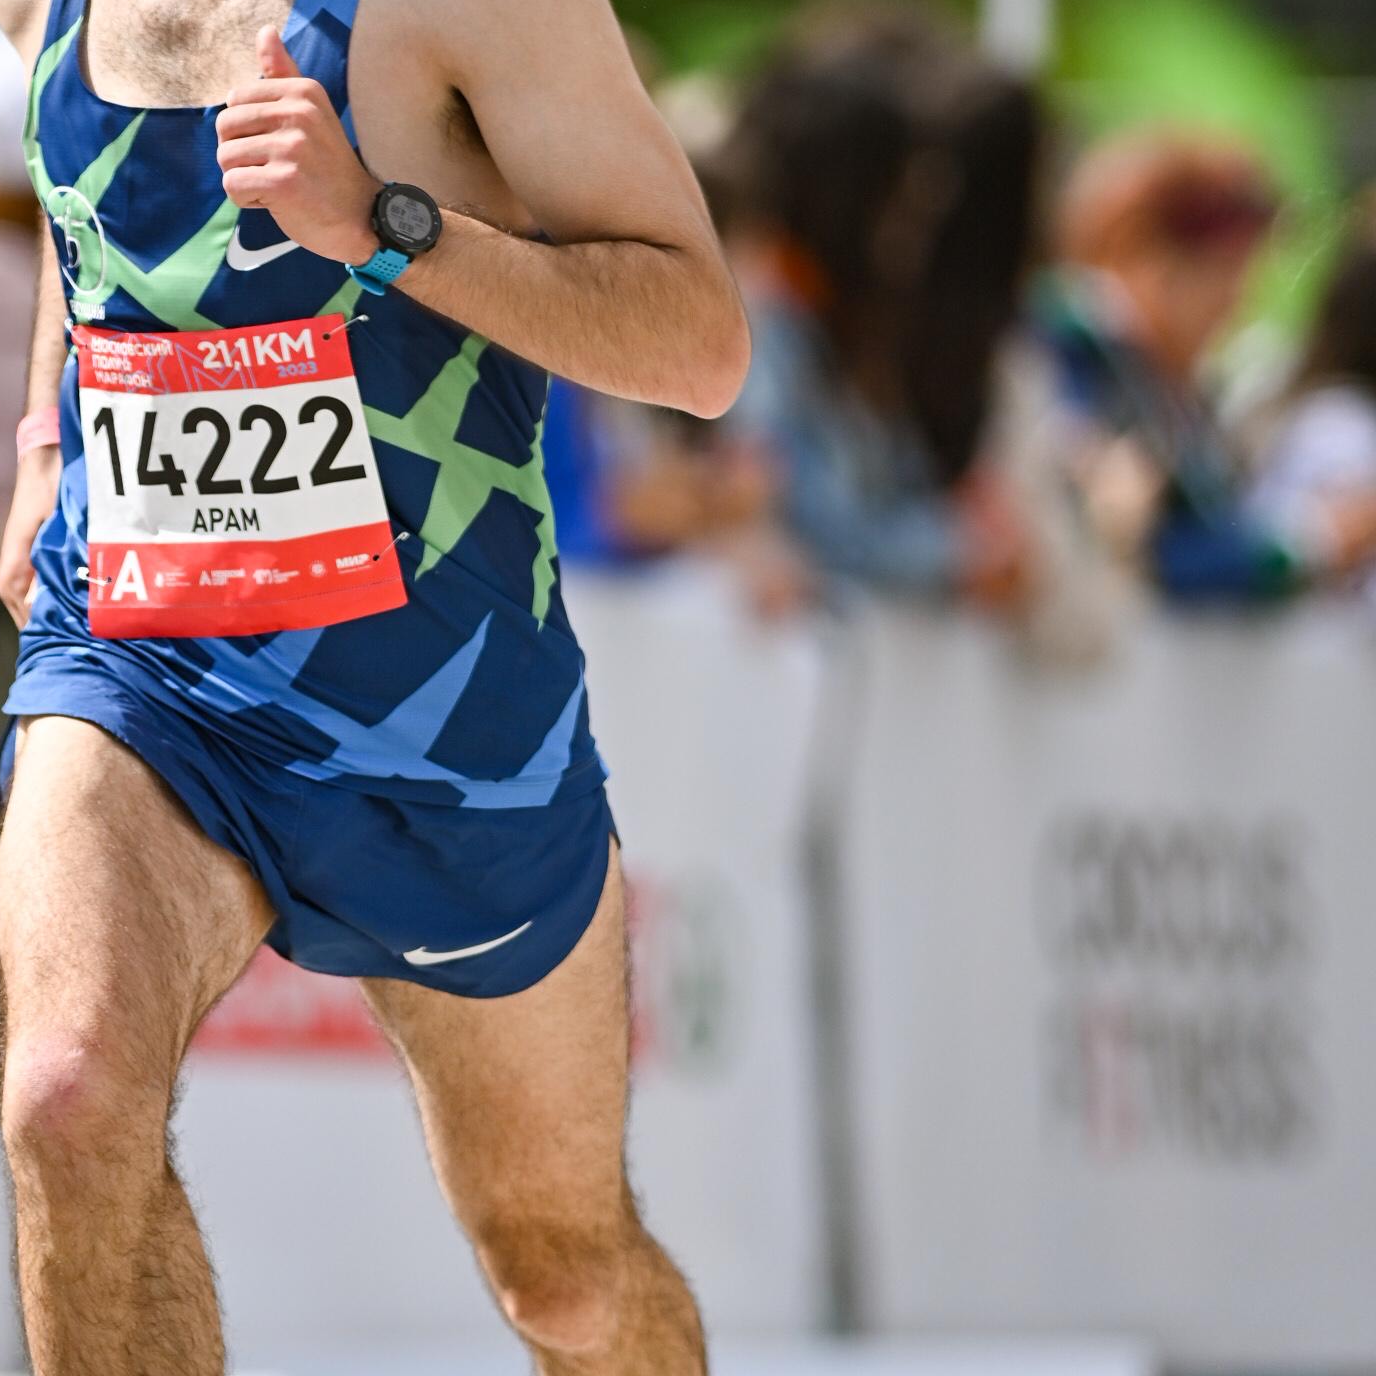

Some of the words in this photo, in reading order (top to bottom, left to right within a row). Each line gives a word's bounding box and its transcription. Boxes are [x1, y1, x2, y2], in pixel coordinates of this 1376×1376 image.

[278, 361, 318, 377] 2023
[94, 395, 367, 496] 14222
[192, 508, 261, 533] АРАМ
